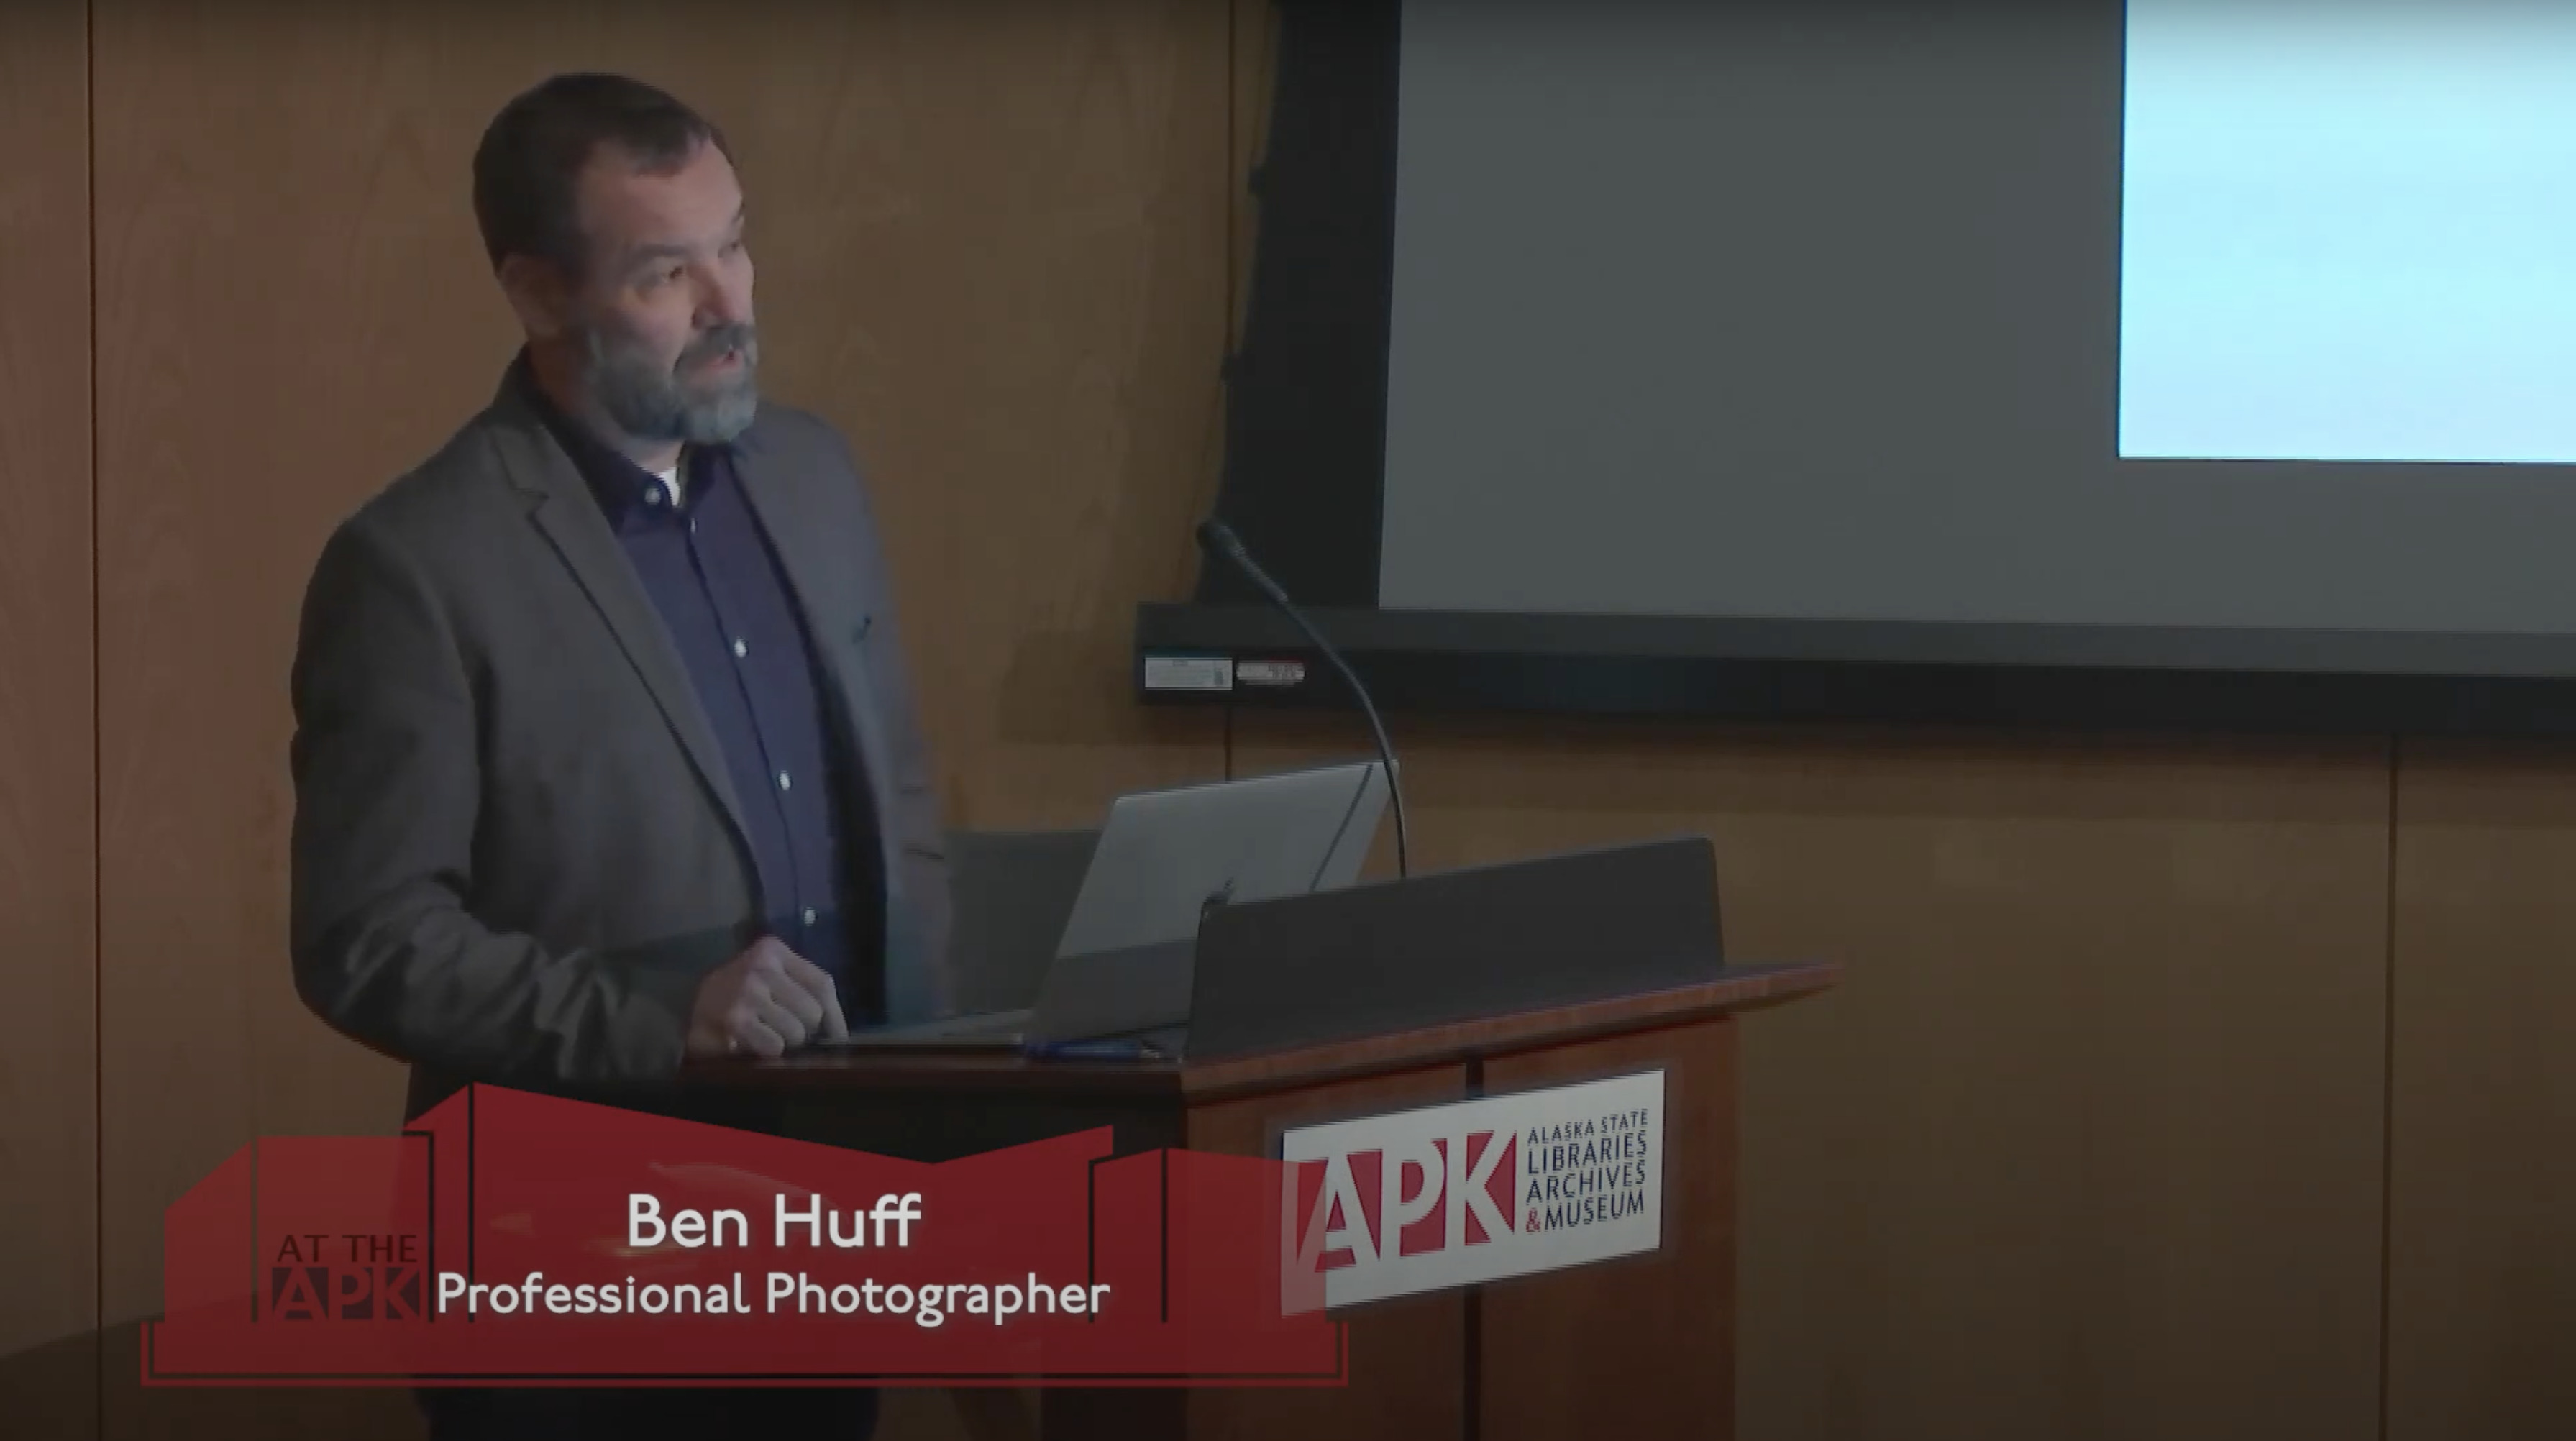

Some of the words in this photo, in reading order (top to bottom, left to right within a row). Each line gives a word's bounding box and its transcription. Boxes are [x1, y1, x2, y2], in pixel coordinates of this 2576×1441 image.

[1527, 1119, 1594, 1145] ALASKA
[1601, 1108, 1648, 1133] STATE
[1528, 1130, 1647, 1175] LIBRARIES
[1297, 1130, 1517, 1273] APK
[1526, 1159, 1645, 1205] ARCHIVES
